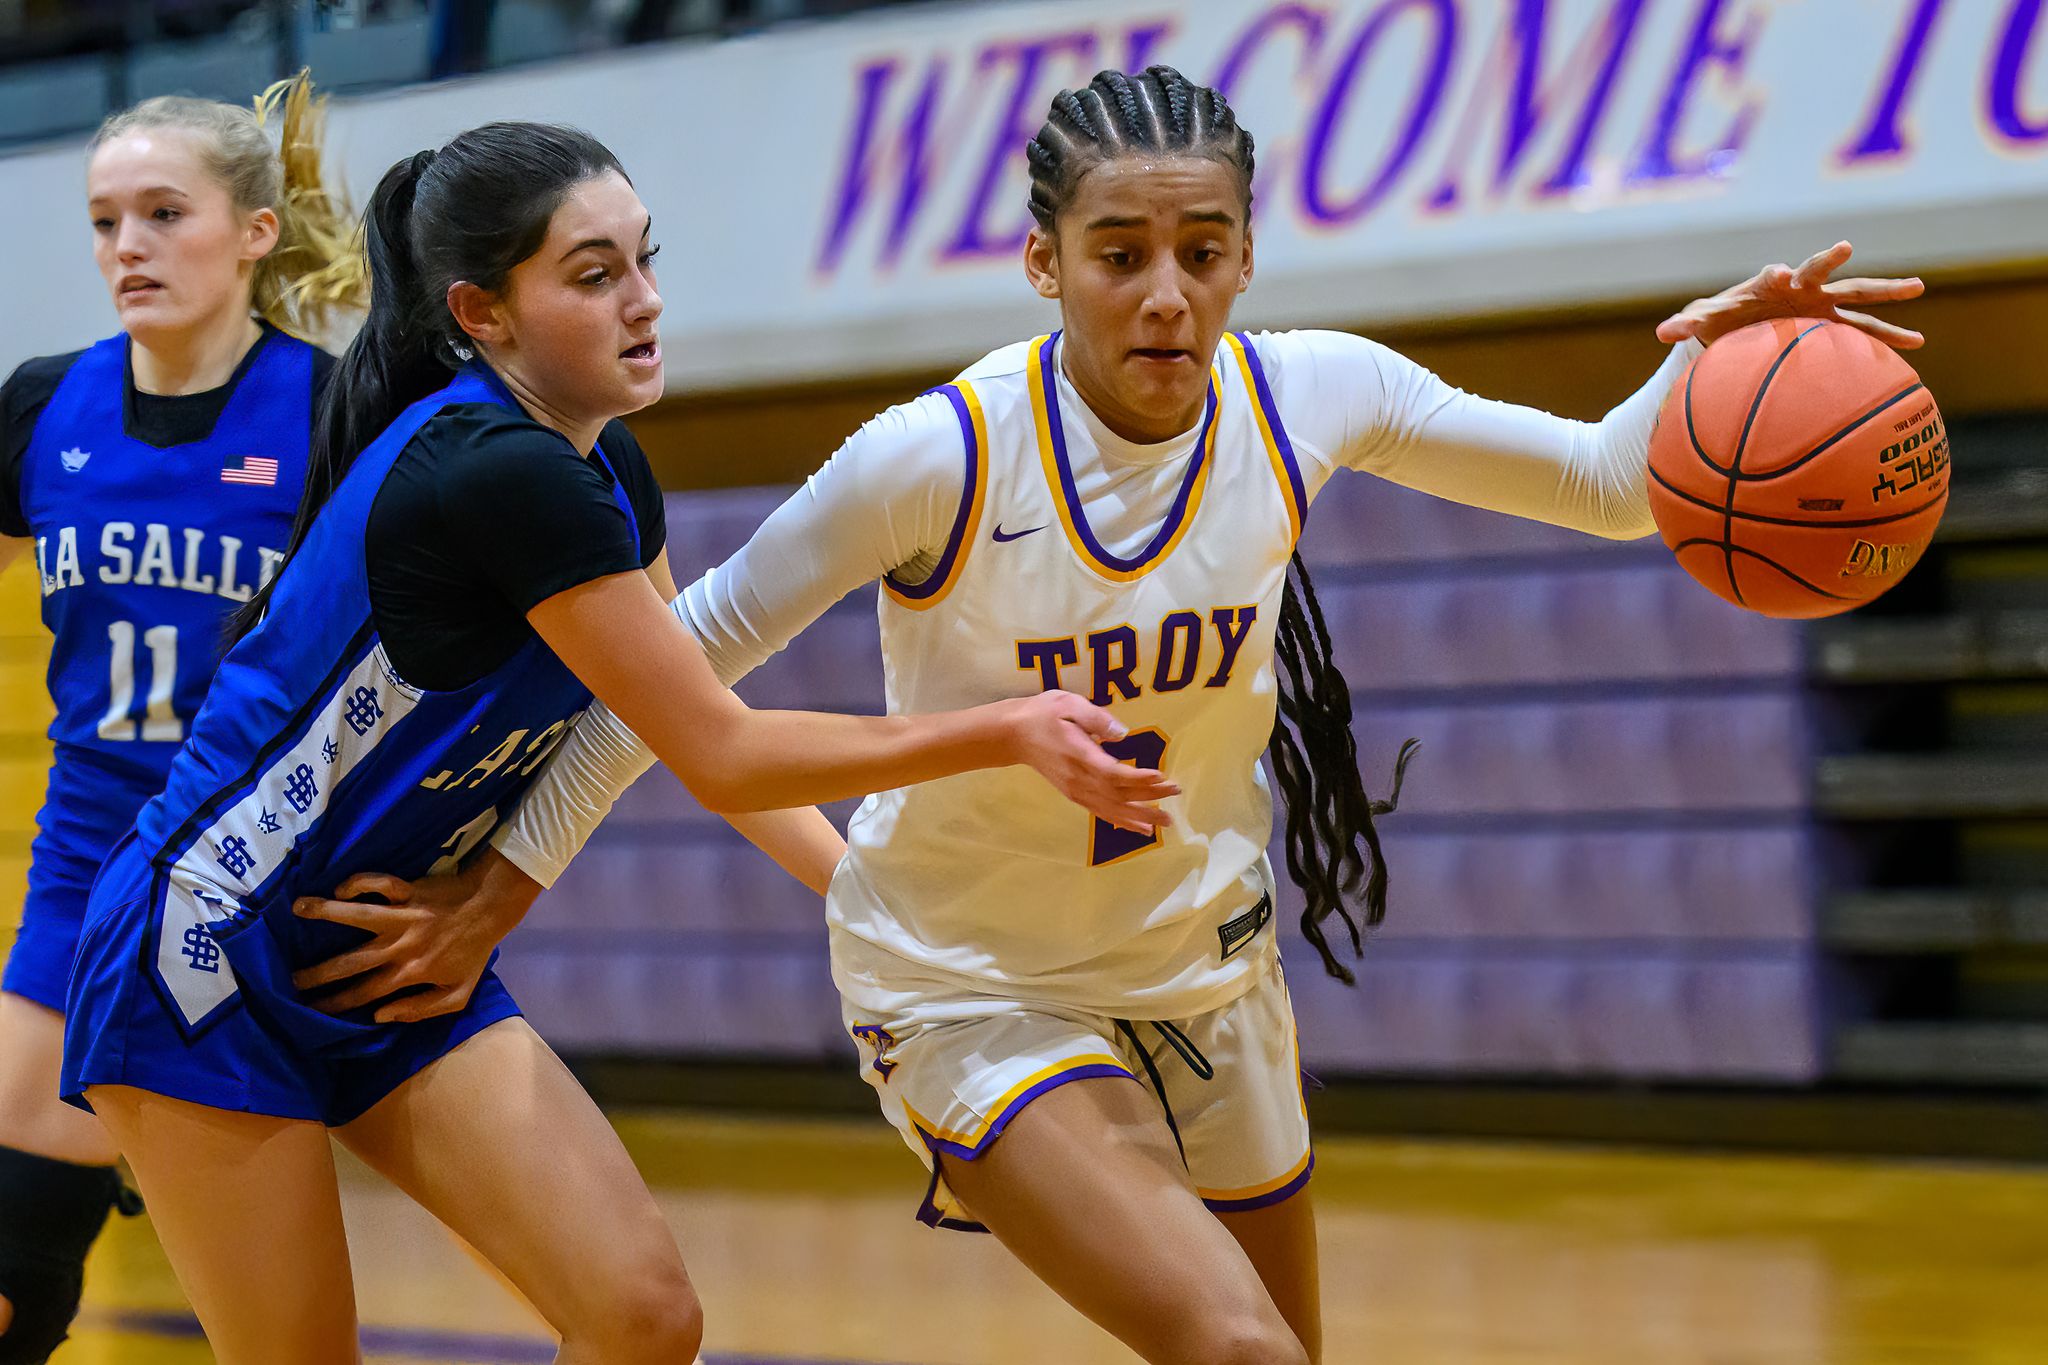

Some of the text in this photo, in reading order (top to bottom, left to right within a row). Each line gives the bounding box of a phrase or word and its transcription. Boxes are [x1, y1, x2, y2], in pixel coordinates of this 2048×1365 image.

[814, 0, 1768, 283] WECOME
[97, 620, 183, 742] 11
[1014, 602, 1259, 707] TROY
